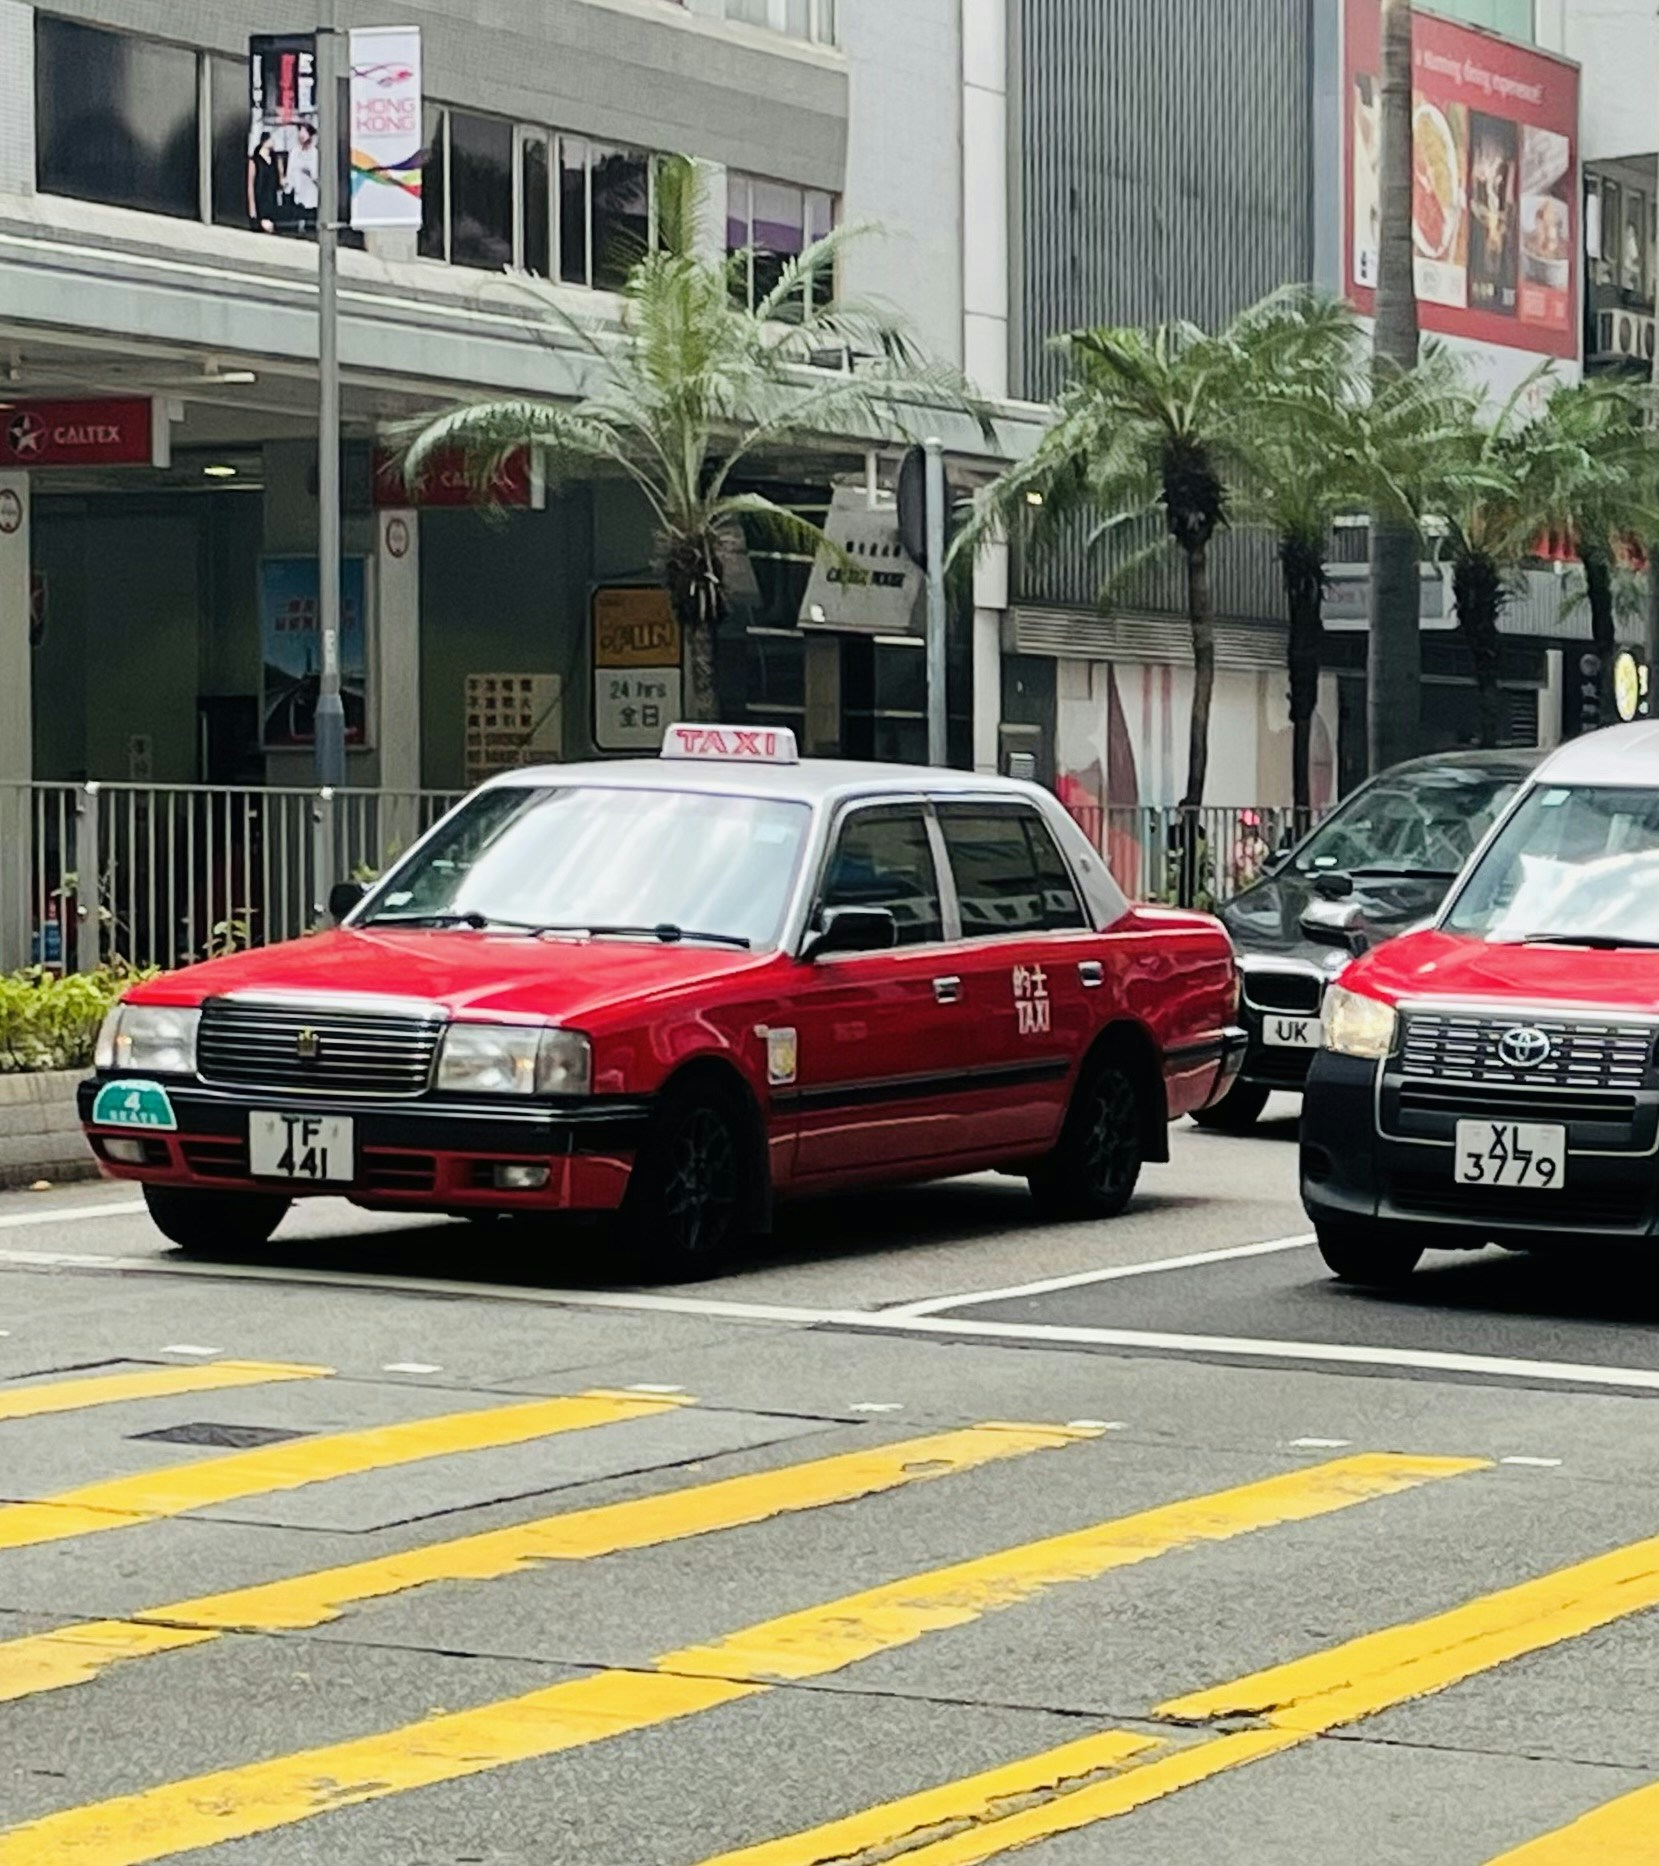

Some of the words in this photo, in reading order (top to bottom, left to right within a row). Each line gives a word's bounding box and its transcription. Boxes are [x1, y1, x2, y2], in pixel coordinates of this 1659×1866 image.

[356, 97, 416, 114] HONG
[356, 115, 416, 132] KONG
[54, 425, 121, 445] CALTEX
[610, 681, 630, 699] 24
[636, 681, 667, 699] hrs
[619, 703, 660, 728] 全日
[676, 728, 776, 757] TAXI
[1013, 963, 1048, 997] 的士
[1015, 998, 1051, 1034] TAXI
[1276, 1019, 1308, 1043] UK
[124, 1091, 142, 1111] 4
[281, 1113, 322, 1148] TF
[1488, 1123, 1534, 1157] XL
[276, 1146, 328, 1180] 441
[1462, 1152, 1557, 1188] 3779
